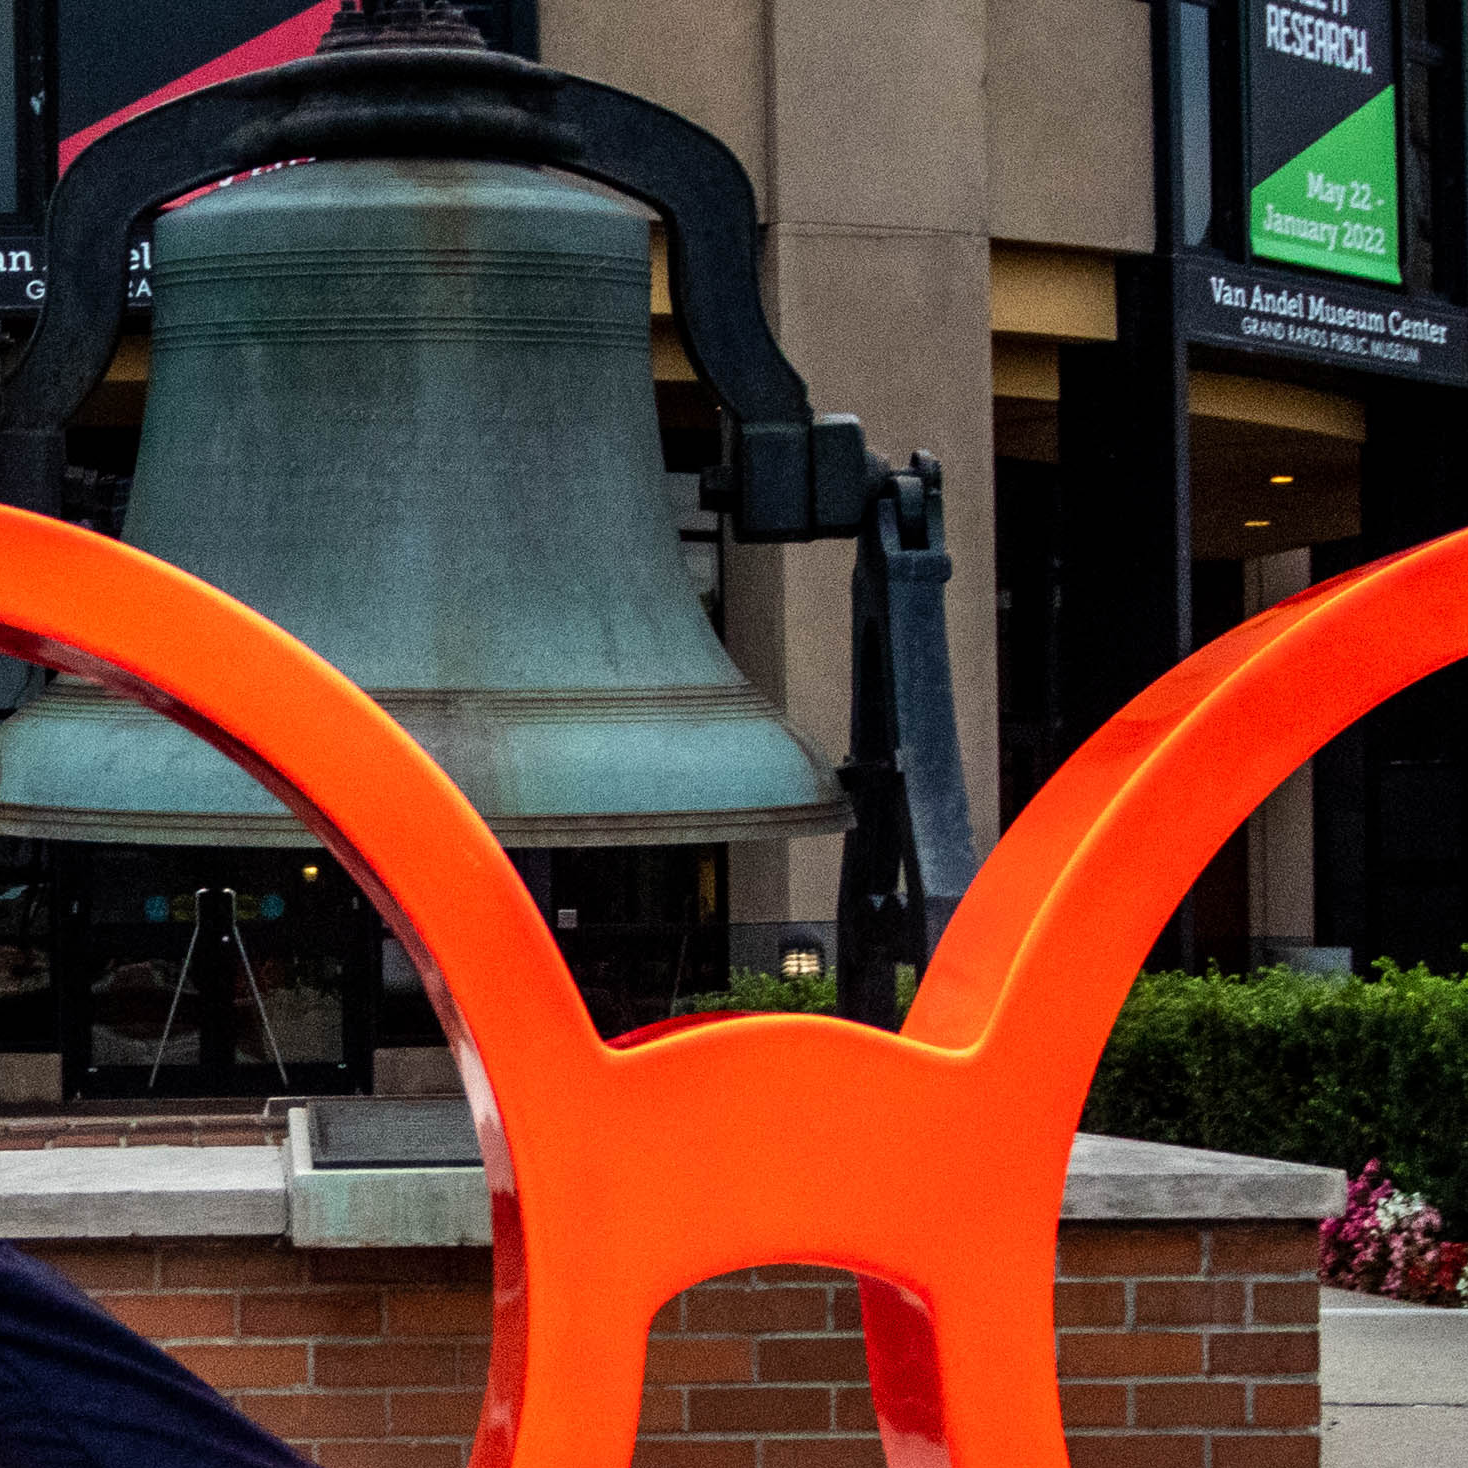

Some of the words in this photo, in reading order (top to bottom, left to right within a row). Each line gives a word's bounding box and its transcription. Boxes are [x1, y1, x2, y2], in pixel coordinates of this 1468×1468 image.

[1266, 3, 1373, 74] RESEARCH.
[1306, 171, 1346, 211] May
[1350, 180, 1373, 211] 22
[1263, 203, 1338, 251] January
[1342, 221, 1386, 255] 2022
[1210, 276, 1246, 308] Van
[1250, 285, 1304, 319] Andel
[1308, 295, 1384, 334] Museum
[1387, 310, 1448, 344] Center
[1241, 316, 1284, 340] GRAND
[1287, 325, 1328, 348] RAPIDS
[1331, 332, 1369, 355] PUBLIC
[1371, 340, 1420, 363] MUSEUM
